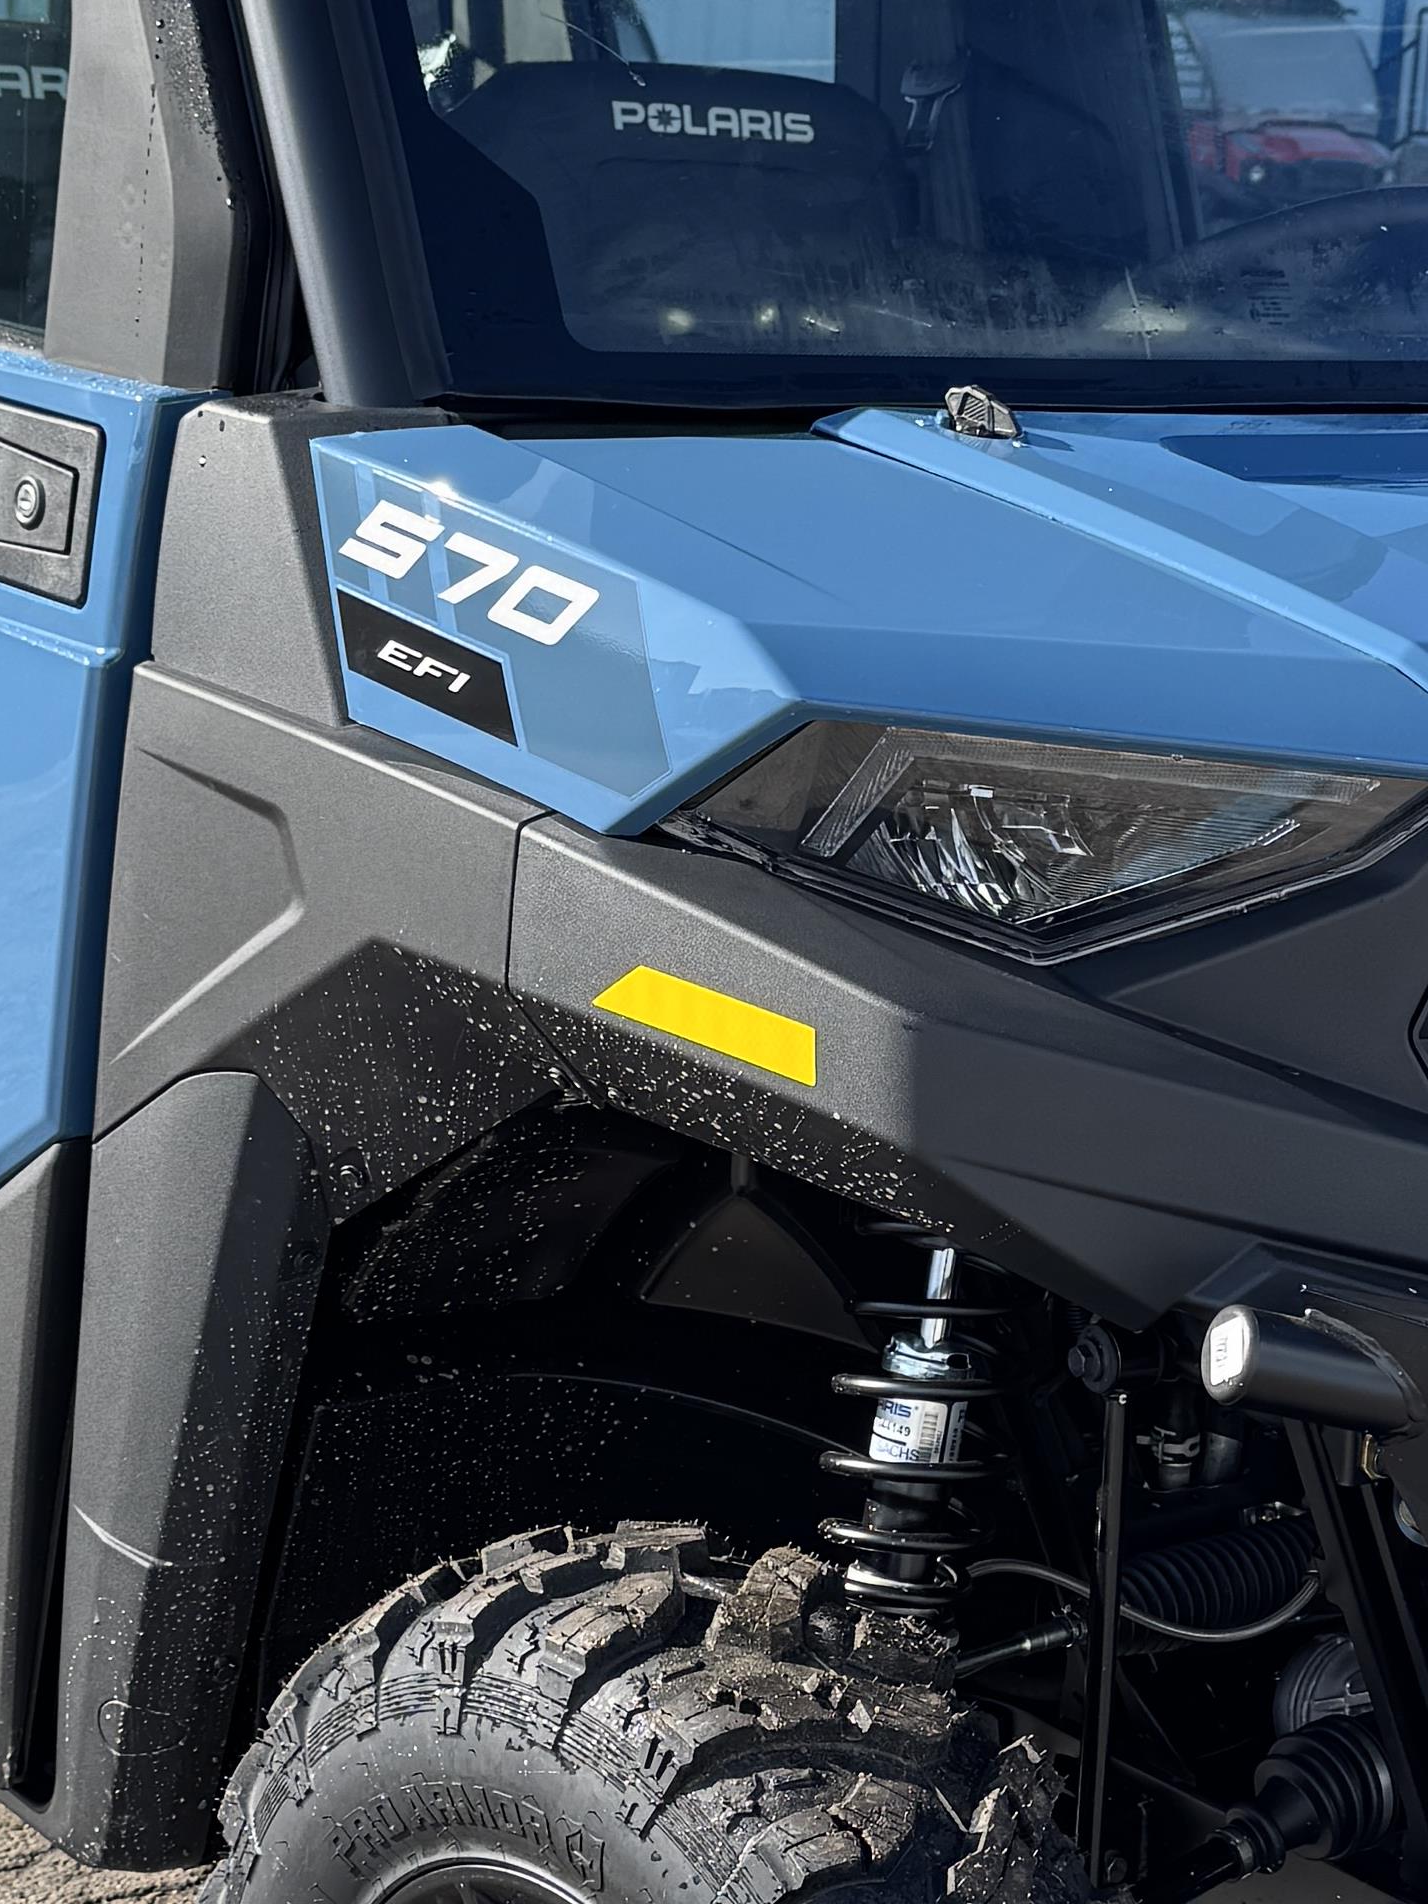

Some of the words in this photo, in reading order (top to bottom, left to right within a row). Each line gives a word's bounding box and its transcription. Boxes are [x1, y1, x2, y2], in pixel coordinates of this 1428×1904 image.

[611, 100, 815, 144] POLARIS
[337, 499, 600, 646] 570
[376, 639, 469, 693] EFI
